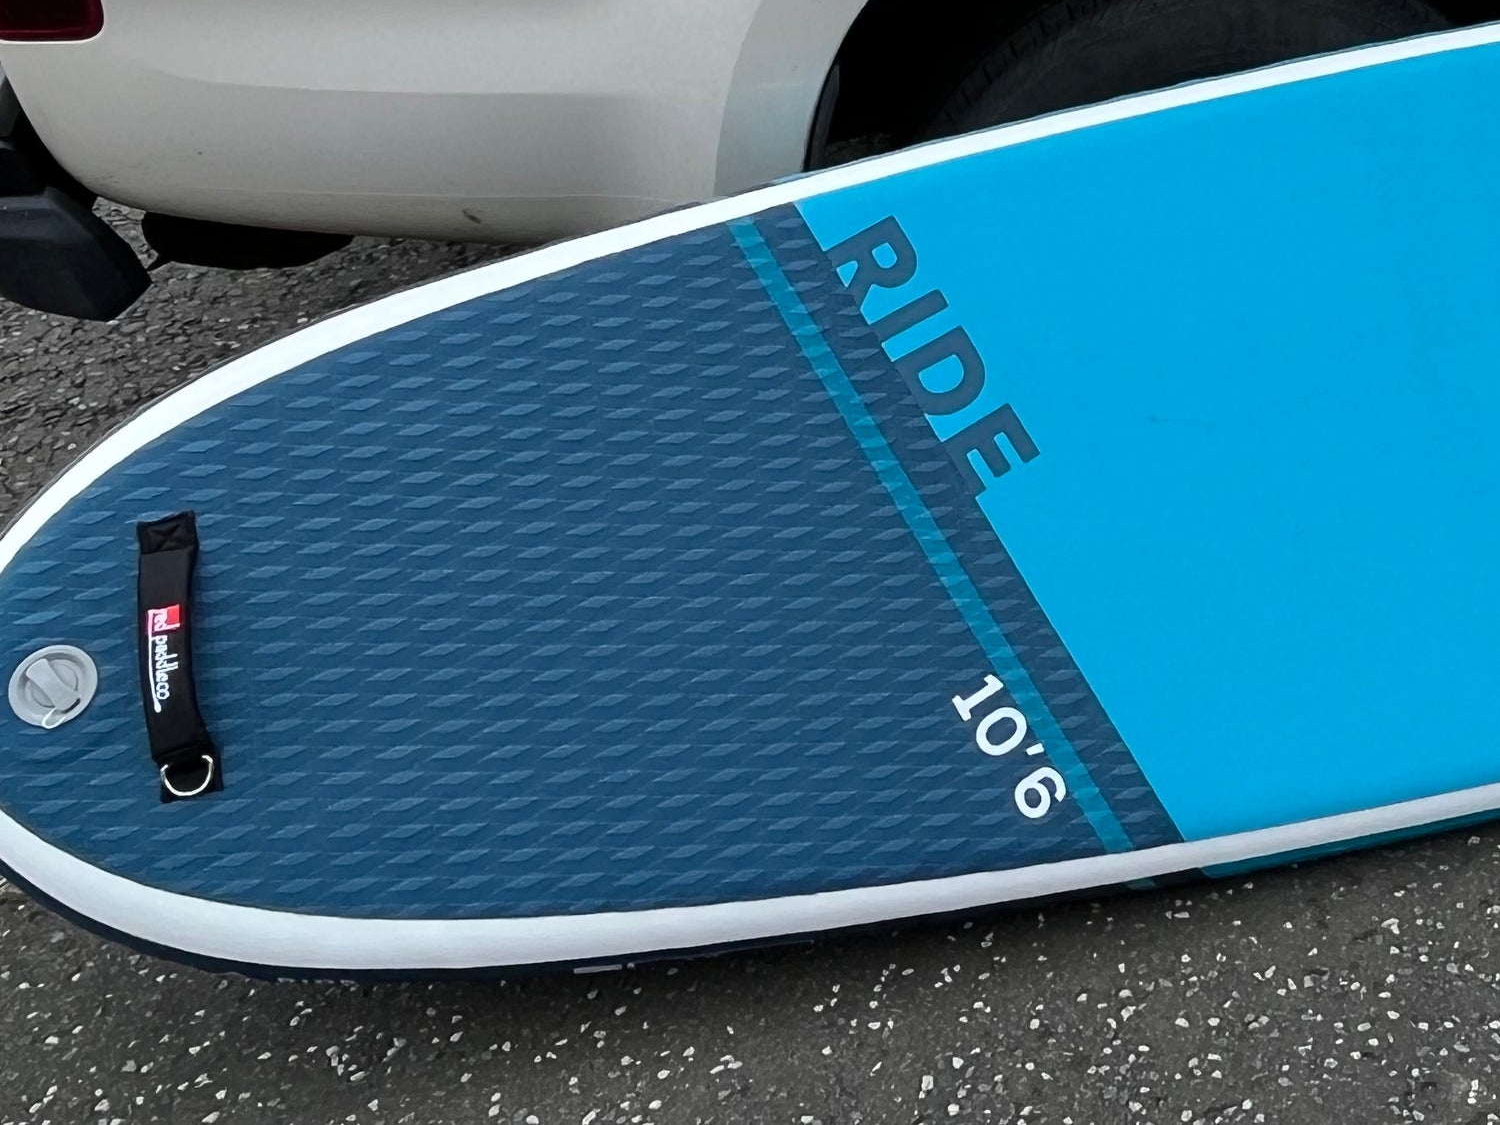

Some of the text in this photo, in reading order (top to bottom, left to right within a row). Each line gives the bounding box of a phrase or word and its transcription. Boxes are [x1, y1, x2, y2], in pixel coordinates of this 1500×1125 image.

[822, 214, 1042, 498] RIDE
[149, 605, 181, 632] red
[951, 674, 1067, 819] 10'6
